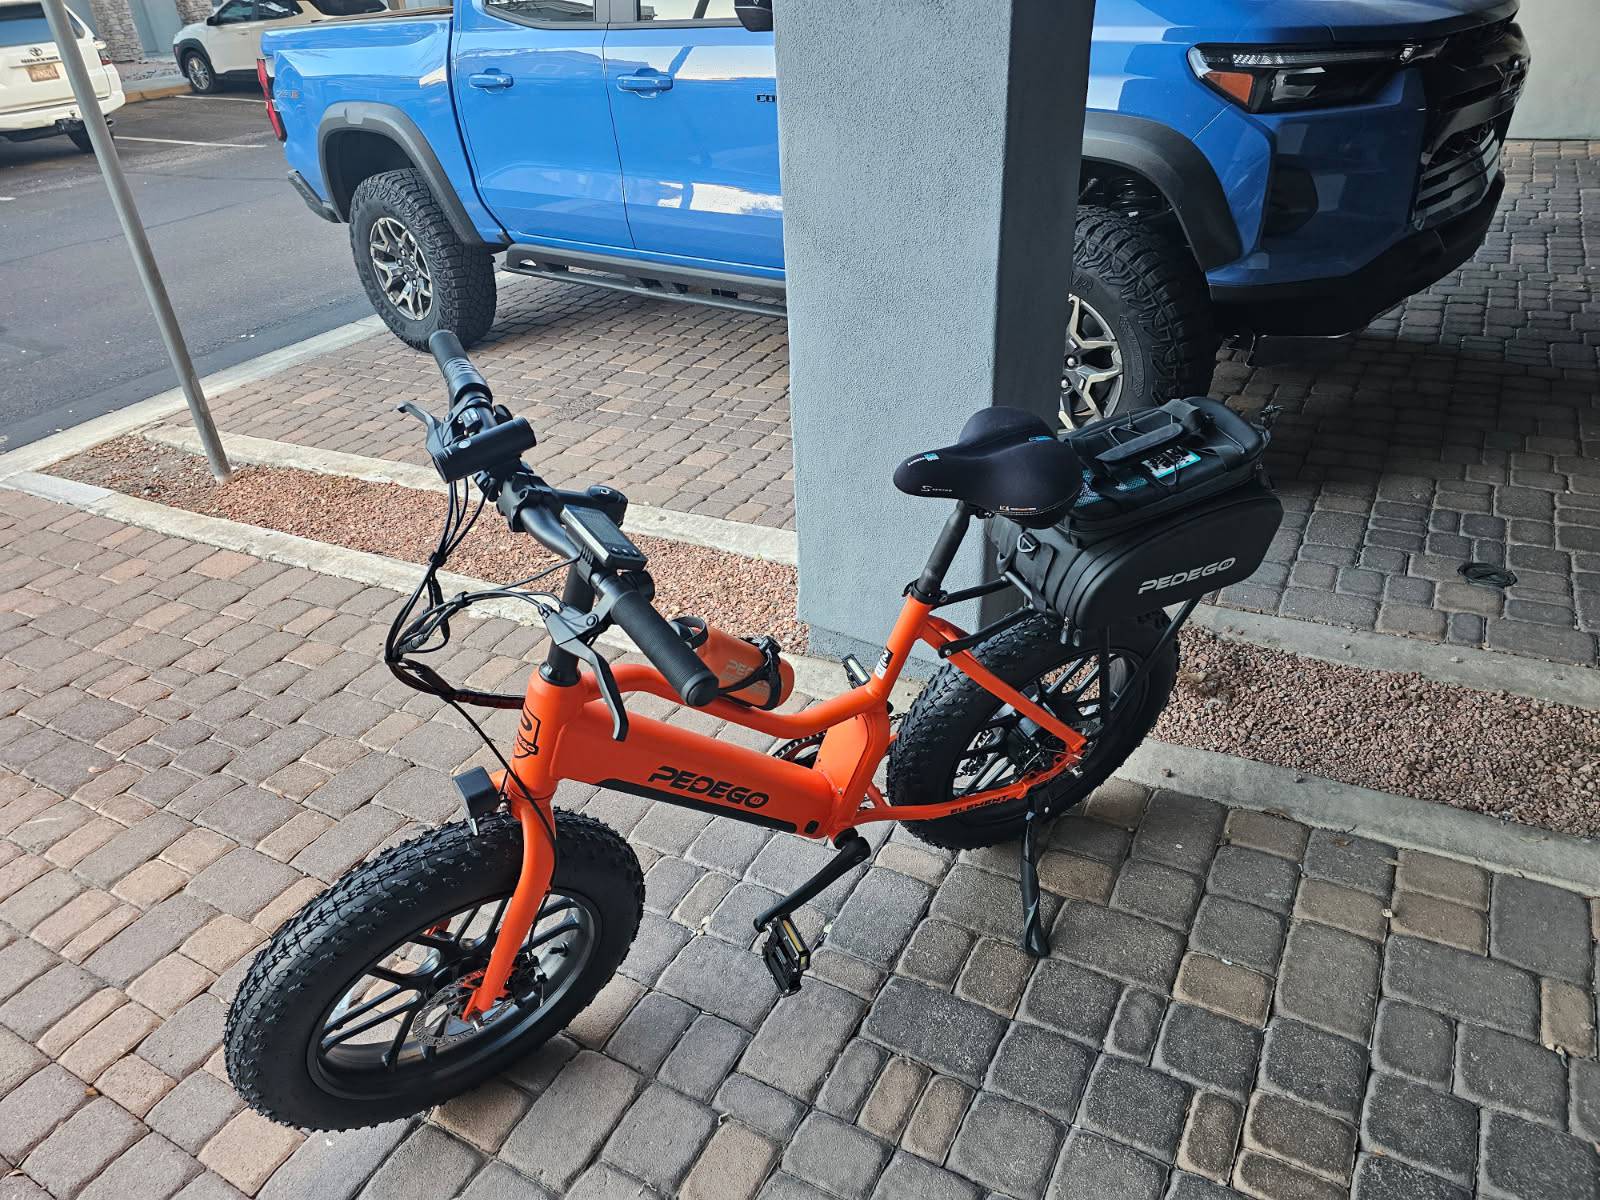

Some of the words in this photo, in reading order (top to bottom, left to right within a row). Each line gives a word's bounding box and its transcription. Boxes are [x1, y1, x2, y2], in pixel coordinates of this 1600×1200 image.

[756, 94, 777, 103] CO
[1137, 557, 1236, 595] PEDEGO
[647, 765, 770, 809] PEDEGO
[950, 794, 1009, 815] ELEMENT
